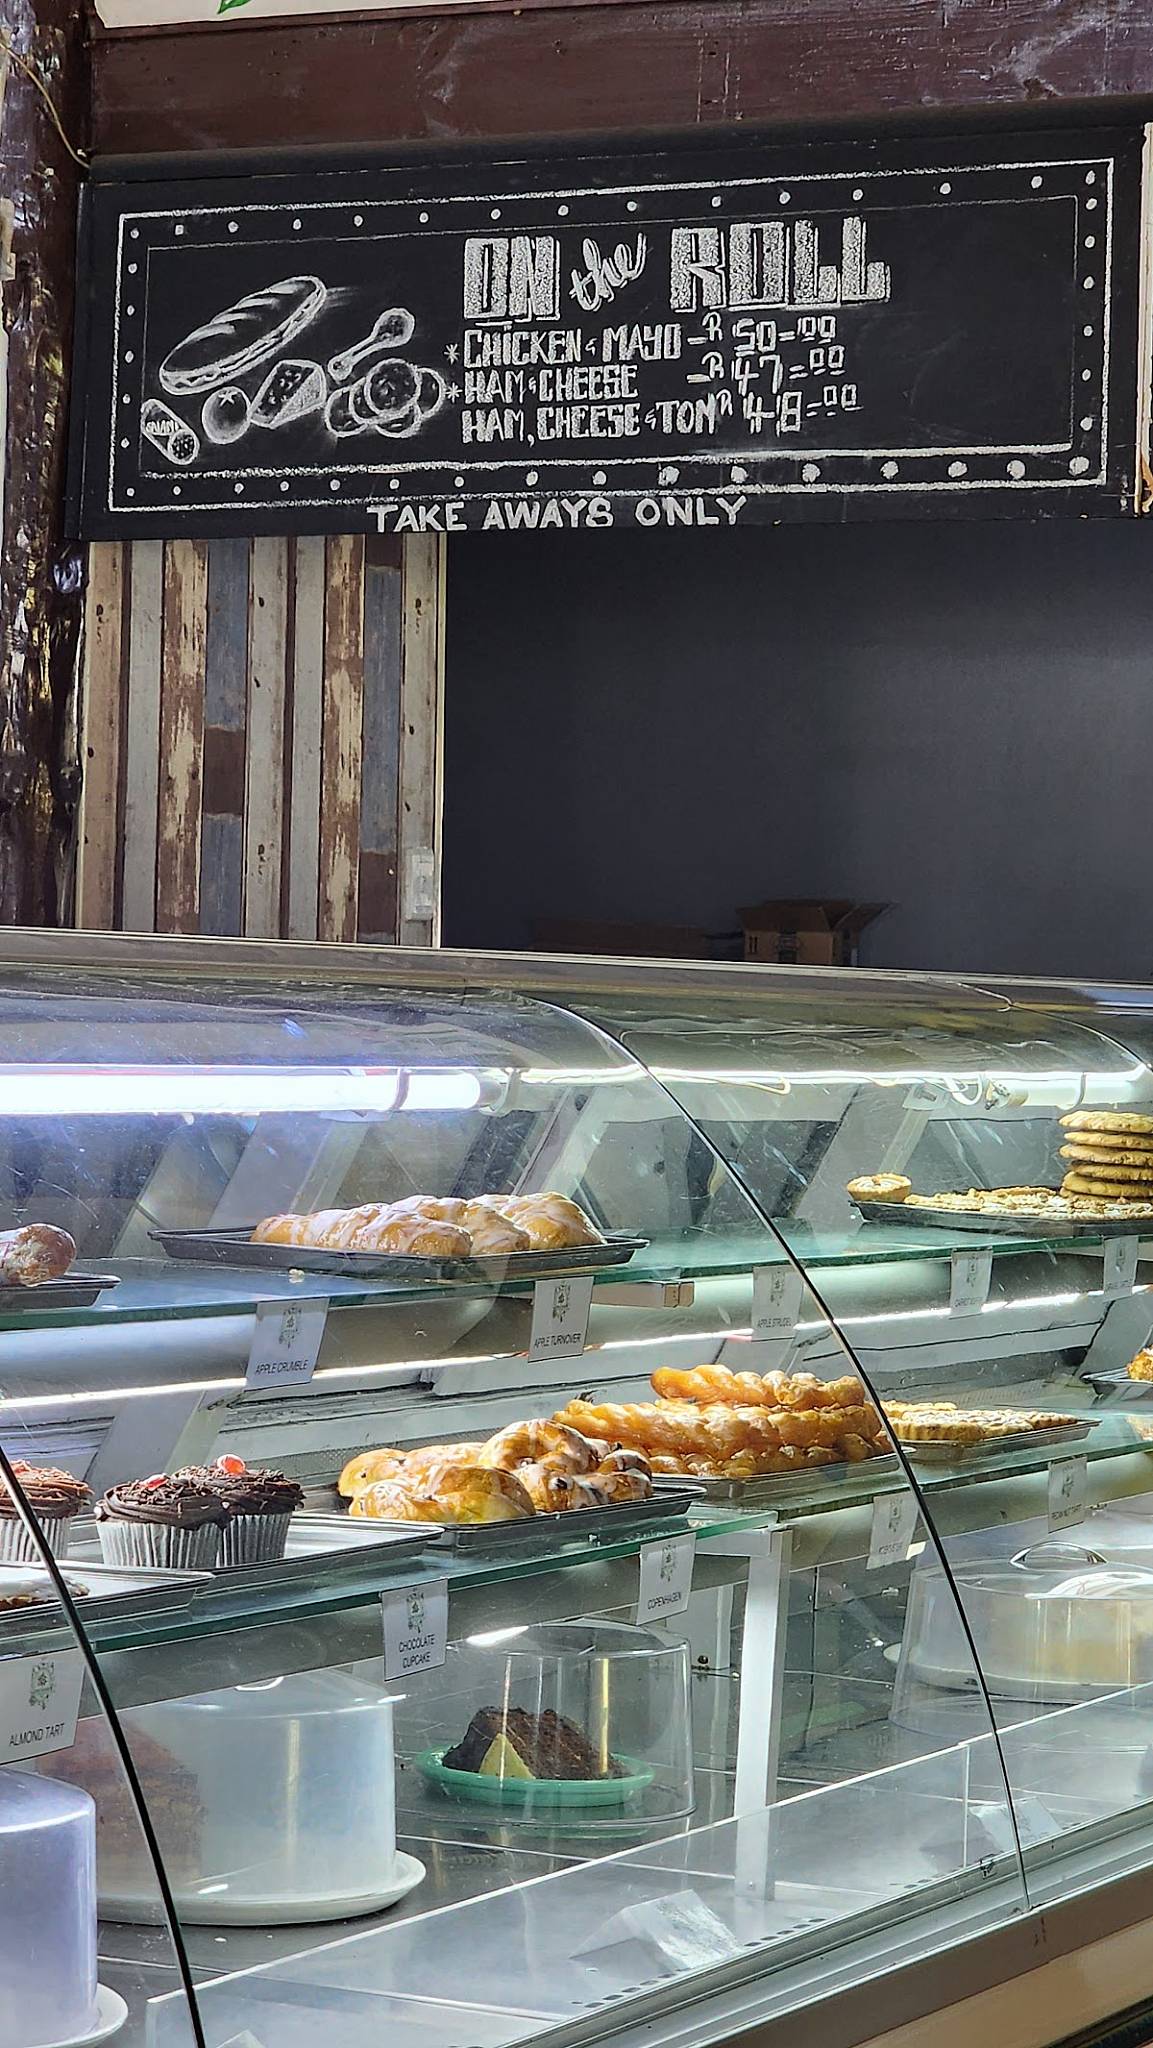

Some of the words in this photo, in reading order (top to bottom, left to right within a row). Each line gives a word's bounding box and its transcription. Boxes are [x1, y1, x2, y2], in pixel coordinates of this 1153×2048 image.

[464, 236, 560, 326] ON
[569, 232, 646, 311] the
[670, 217, 892, 312] ROLL
[464, 325, 582, 368] CHICKEN
[602, 322, 683, 361] MAYO
[365, 500, 468, 533] TAKE
[480, 497, 615, 530] AWAYS
[634, 494, 748, 527] ONLY
[255, 1362, 278, 1375] APPLE
[278, 1359, 309, 1373] CRUMBLE
[647, 1591, 682, 1610] COPENHAGEN
[399, 1633, 436, 1653] CHOCOLATE
[402, 1651, 432, 1669] CUPCAKE
[9, 1728, 44, 1747] ALMOND
[45, 1722, 65, 1739] TART
